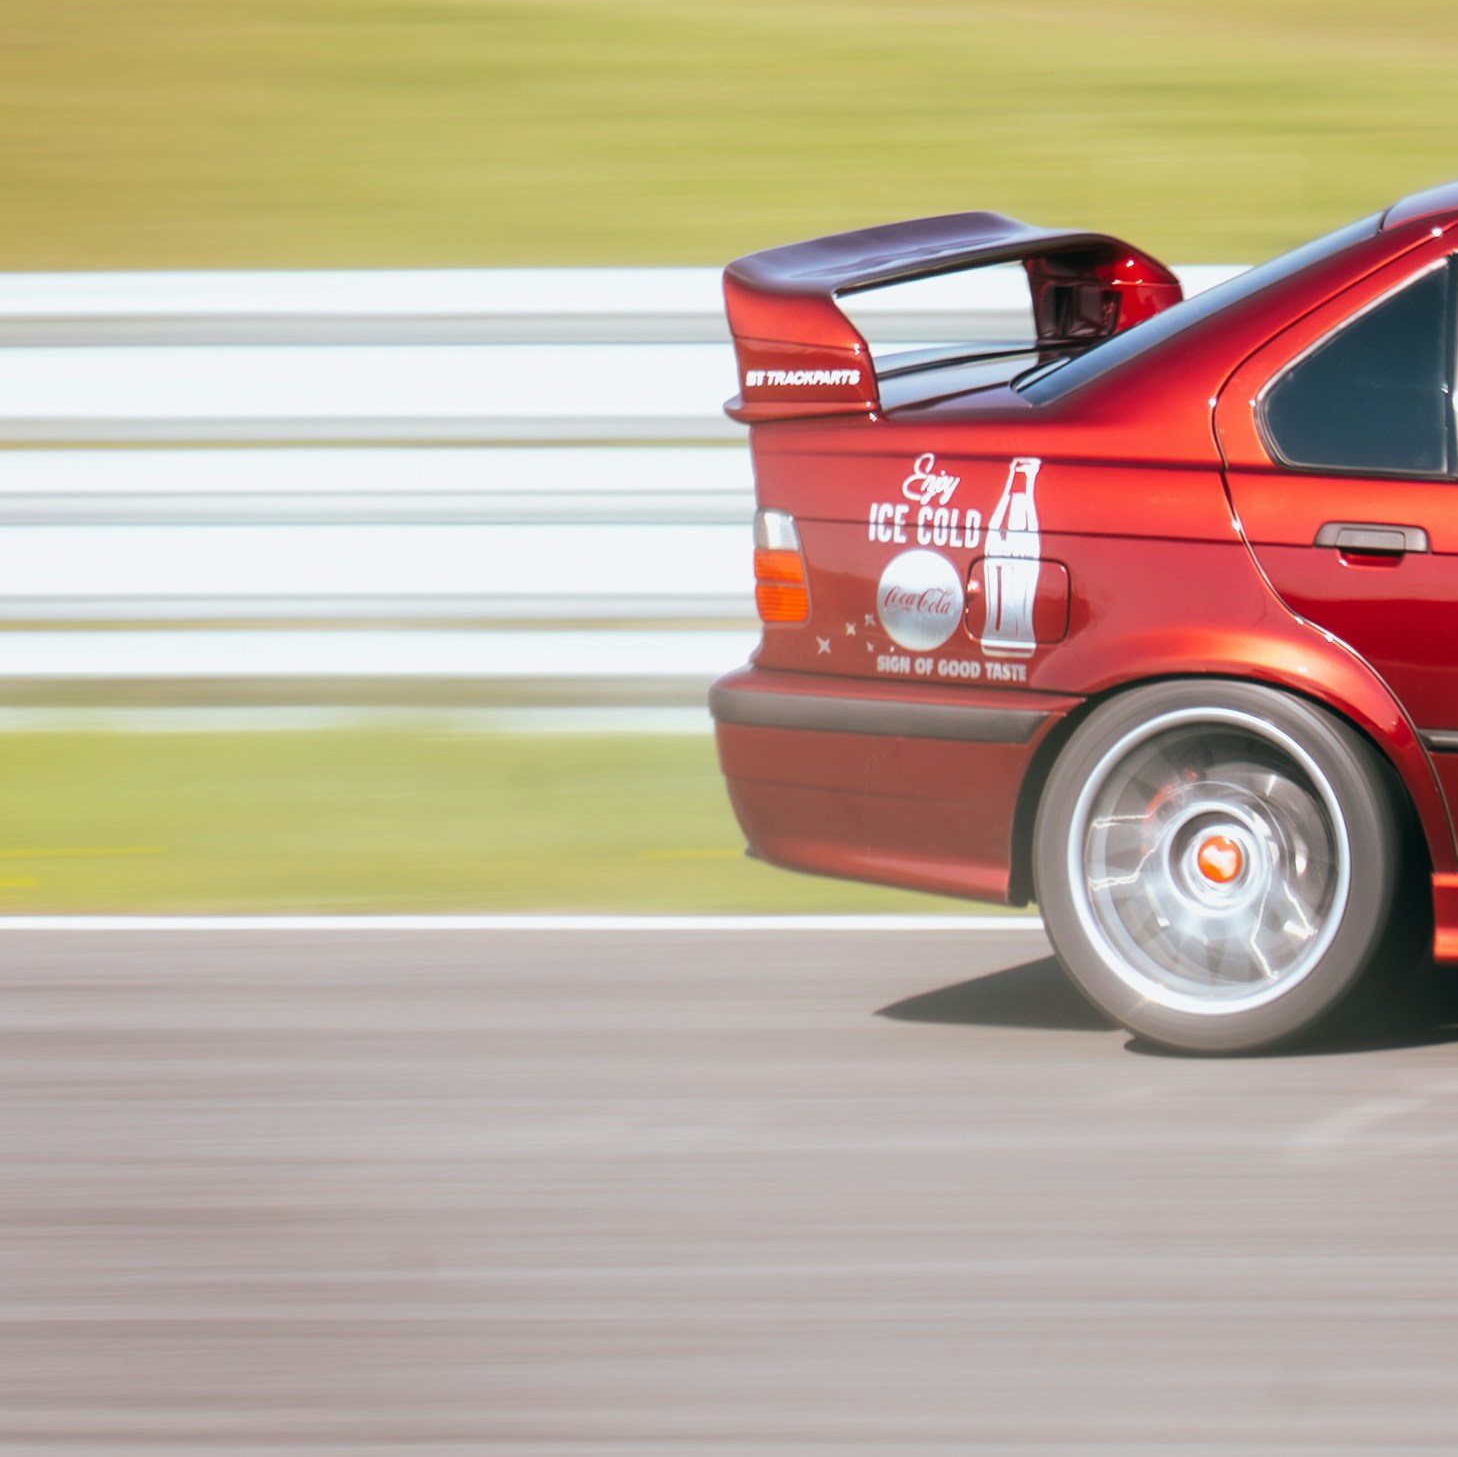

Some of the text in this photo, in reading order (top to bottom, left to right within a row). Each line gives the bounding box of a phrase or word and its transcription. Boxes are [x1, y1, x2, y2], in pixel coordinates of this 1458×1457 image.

[902, 452, 961, 506] Enjoy
[868, 502, 983, 549] ICE COLD
[876, 654, 1027, 682] SIGN OF GOOD TASTE
